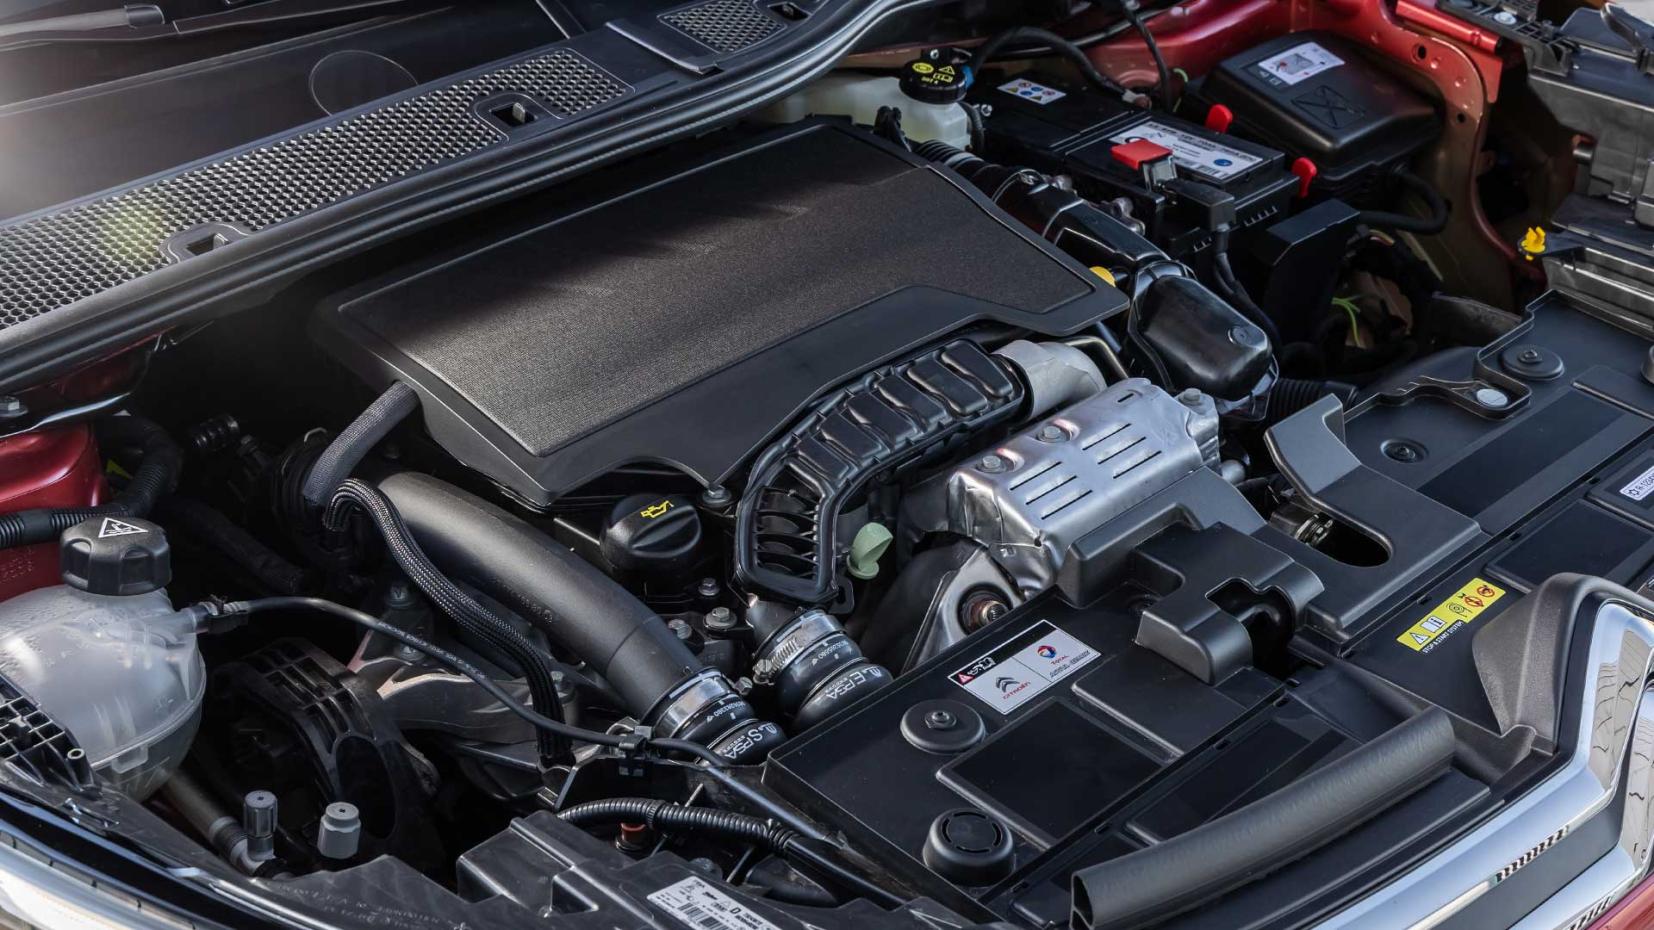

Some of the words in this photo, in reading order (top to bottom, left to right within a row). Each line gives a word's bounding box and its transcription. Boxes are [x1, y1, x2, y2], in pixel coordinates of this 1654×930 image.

[849, 671, 867, 686] E
[826, 681, 856, 700] PSA
[747, 728, 763, 742] S
[724, 737, 755, 760] PSA
[730, 906, 742, 915] D
